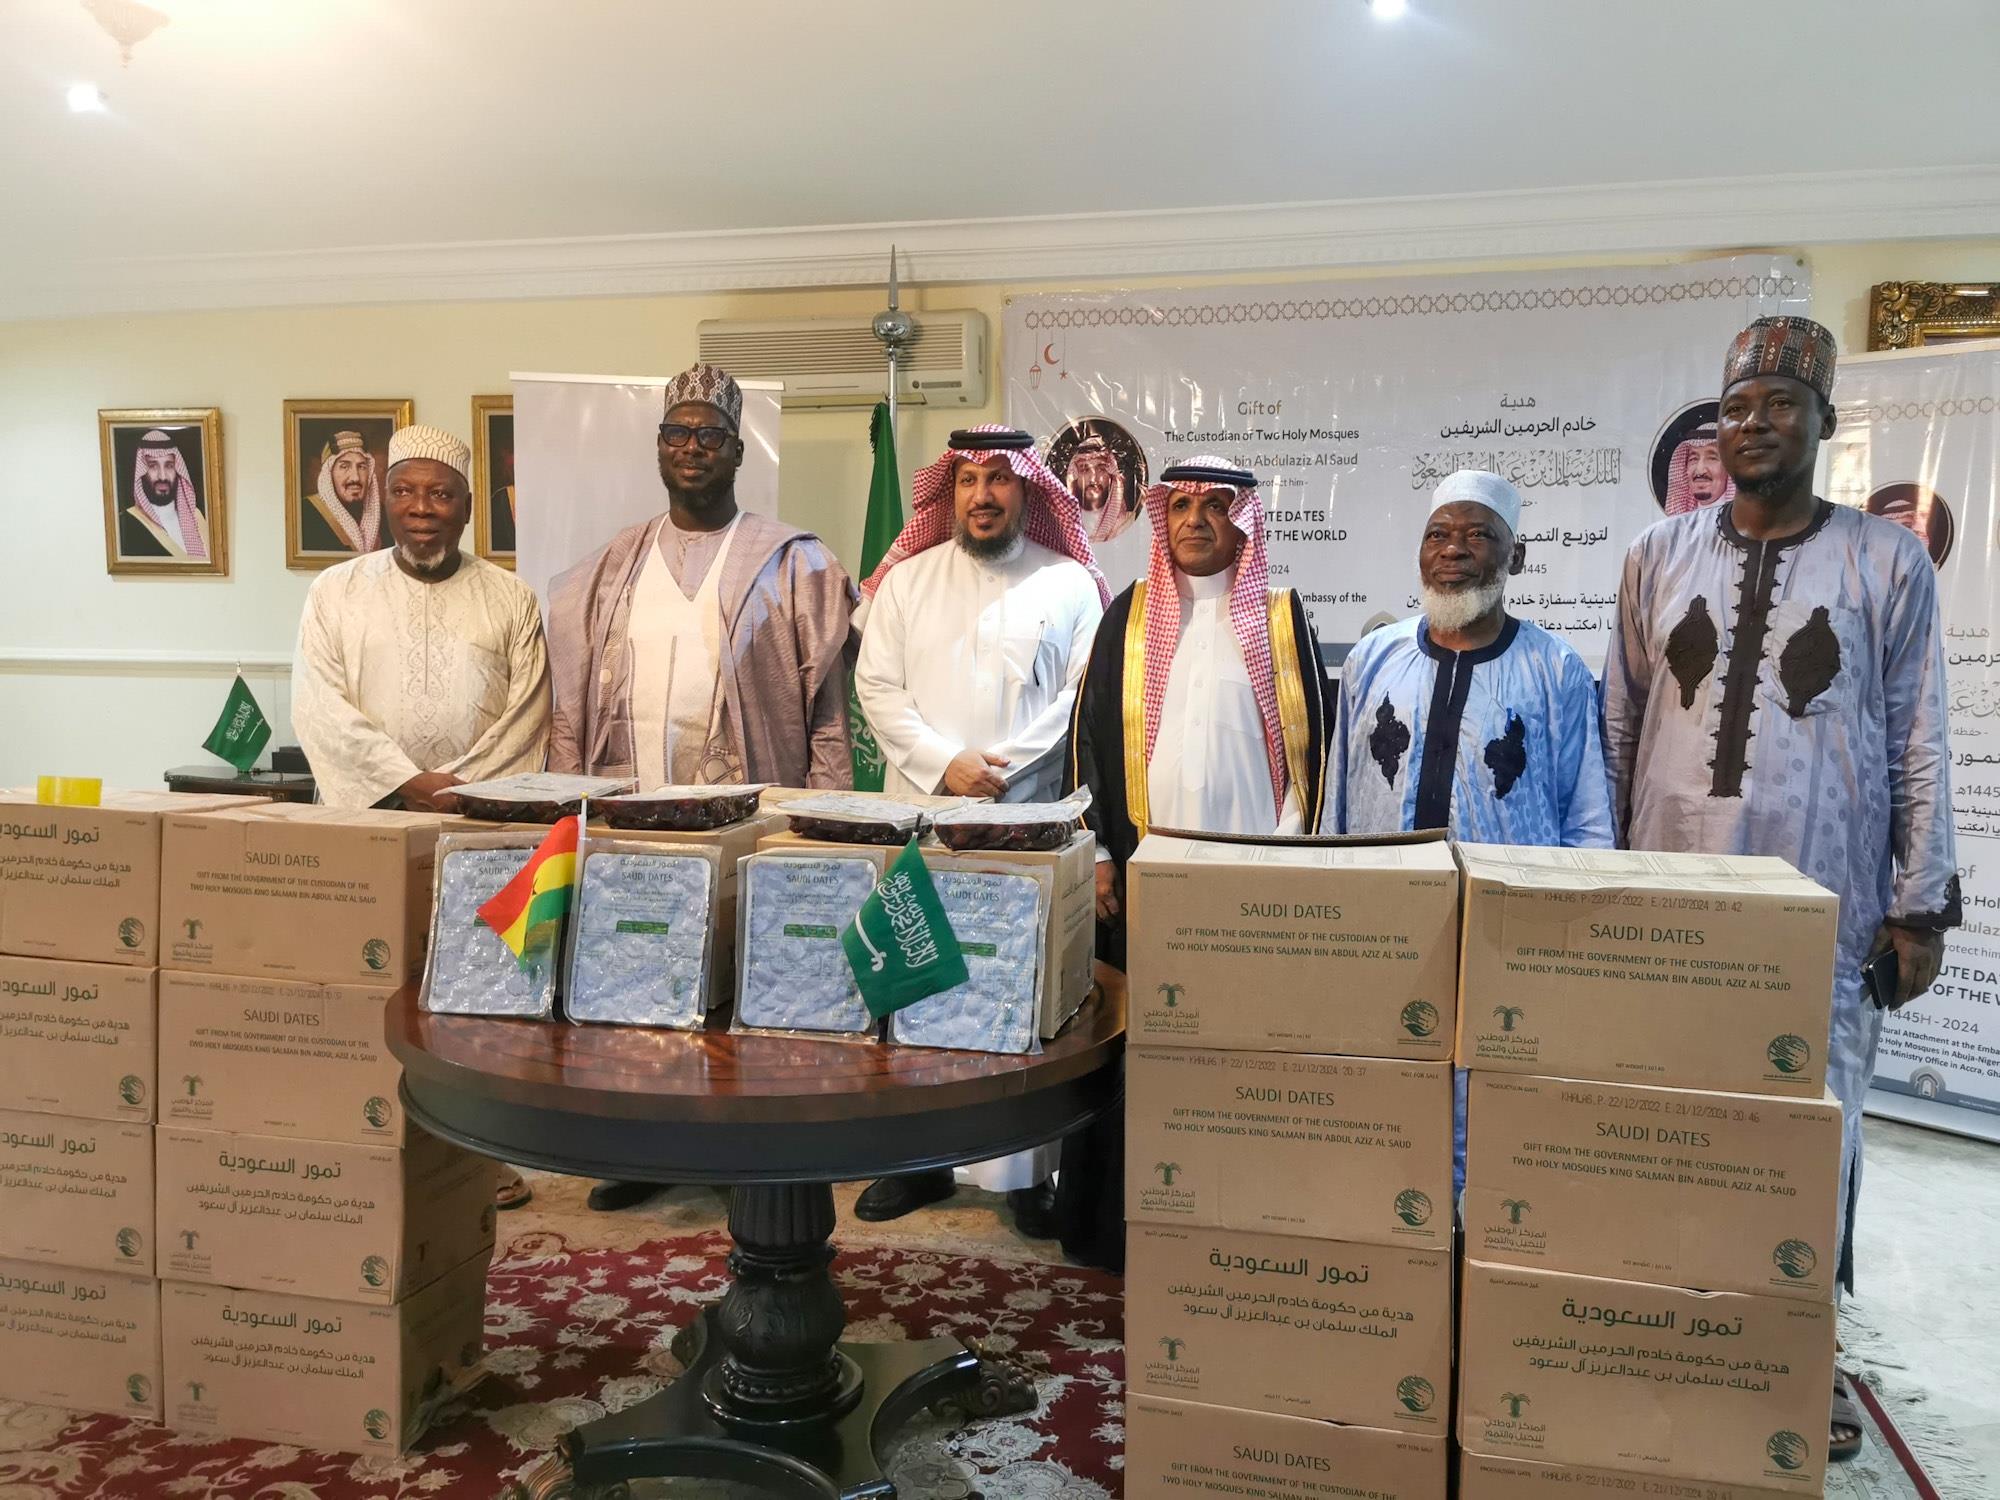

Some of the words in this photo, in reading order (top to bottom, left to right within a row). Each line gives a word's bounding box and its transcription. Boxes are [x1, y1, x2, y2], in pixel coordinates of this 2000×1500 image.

[1237, 401, 1264, 415] Gift
[1267, 400, 1281, 414] of
[1500, 393, 1536, 411] هدية
[1440, 418, 1501, 438] الشريفين
[1504, 417, 1560, 436] الحرمين
[1562, 416, 1596, 436] خادم
[1164, 428, 1185, 442] The
[1186, 430, 1240, 441] Custodian
[1282, 428, 1307, 441] Holy
[1309, 429, 1359, 441] Mosques
[1234, 454, 1252, 468] bin
[1253, 454, 1312, 466] Abdulaziz
[1314, 453, 1327, 465] Al
[1329, 453, 1357, 465] Saud
[1285, 510, 1324, 522] DATES
[1276, 530, 1298, 541] THE
[1302, 529, 1347, 541] WORLD
[1514, 527, 1558, 545] التمور
[1562, 526, 1607, 547] لتوزيع
[1339, 592, 1350, 602] of
[1352, 592, 1367, 602] the
[1508, 594, 1536, 610] خادم
[1538, 594, 1576, 608] بسفارة
[1945, 627, 1989, 640] هدية
[62, 829, 99, 844] تمور
[244, 851, 280, 865] SAUDI
[284, 854, 319, 867] DATES
[1240, 903, 1286, 917] SAUDI
[1294, 904, 1341, 919] DATES
[1176, 927, 1192, 935] GIFT
[1195, 928, 1219, 936] FROM
[1220, 929, 1237, 937] THE
[1239, 930, 1296, 939] GOVERNMENT
[1298, 931, 1311, 940] OF
[1311, 932, 1327, 941] THE
[1329, 933, 1377, 942] CUSTODIAN
[1379, 935, 1391, 943] OF
[1393, 935, 1408, 944] THE
[1590, 924, 1642, 940] SAUDI
[1650, 928, 1704, 944] DATES
[1517, 947, 1535, 955] GIFT
[1538, 948, 1567, 959] FROM
[1567, 951, 1585, 960] THE
[1586, 952, 1651, 965] GOVERNMENT
[1654, 957, 1670, 965] OF
[1670, 958, 1687, 967] THE
[1690, 960, 1745, 971] CUSTODIAN
[1747, 963, 1763, 972] OF
[1763, 964, 1780, 973] THE
[1506, 962, 1526, 971] TWO
[1529, 964, 1552, 973] HOLY
[1555, 965, 1599, 976] MOSQUES
[1603, 969, 1625, 979] KING
[1628, 971, 1668, 981] SALMAN
[1672, 974, 1688, 983] BIN
[1691, 976, 1722, 986] ABDUL
[1725, 978, 1746, 987] AZIZ
[1749, 980, 1762, 989] AL
[1764, 981, 1790, 990] SAUD
[61, 984, 98, 1001] تمور
[1933, 984, 1954, 996] OF
[1958, 987, 1991, 1004] THE
[243, 1009, 279, 1023] SAUDI
[283, 1012, 319, 1026] DATES
[1942, 1018, 1980, 1034] 2024
[1885, 1038, 1902, 1048] Holy
[1905, 1041, 1940, 1054] Mosques
[1942, 1048, 1949, 1056] in
[1903, 1030, 1949, 1045] Attachment
[1962, 1042, 1975, 1050] the
[1891, 1050, 1923, 1063] Ministry
[1925, 1056, 1948, 1067] Office
[1950, 1061, 1957, 1069] in
[1960, 1064, 1984, 1076] Accra,
[1236, 1086, 1281, 1101] SAUDI
[1288, 1090, 1334, 1105] DATES
[1596, 1122, 1648, 1141] SAUDI
[1656, 1129, 1710, 1147] DATES
[59, 1138, 95, 1154] تمور
[219, 1151, 294, 1173] السعودية
[301, 1162, 340, 1179] تمور
[1209, 1253, 1307, 1275] السعودية
[1316, 1265, 1368, 1283] تمور
[222, 1305, 296, 1327] السعودية
[1562, 1304, 1675, 1327] السعودية
[302, 1317, 341, 1334] تمور
[1683, 1317, 1742, 1336] تمور
[1512, 1338, 1575, 1350] الشريفين
[1578, 1345, 1634, 1357] الحرمين
[1529, 1357, 1568, 1368] سعود
[1637, 1349, 1672, 1360] خادم
[1675, 1352, 1724, 1366] حكومة
[1571, 1359, 1586, 1373] آل
[1587, 1363, 1650, 1377] عبدالعزيز
[1728, 1361, 1750, 1370] من
[1754, 1360, 1788, 1374] هدية
[1654, 1372, 1672, 1382] بن
[1675, 1371, 1723, 1385] سلمان
[1726, 1378, 1769, 1391] الملك
[1233, 1446, 1278, 1463] SAUDI
[1285, 1453, 1330, 1471] DATES
